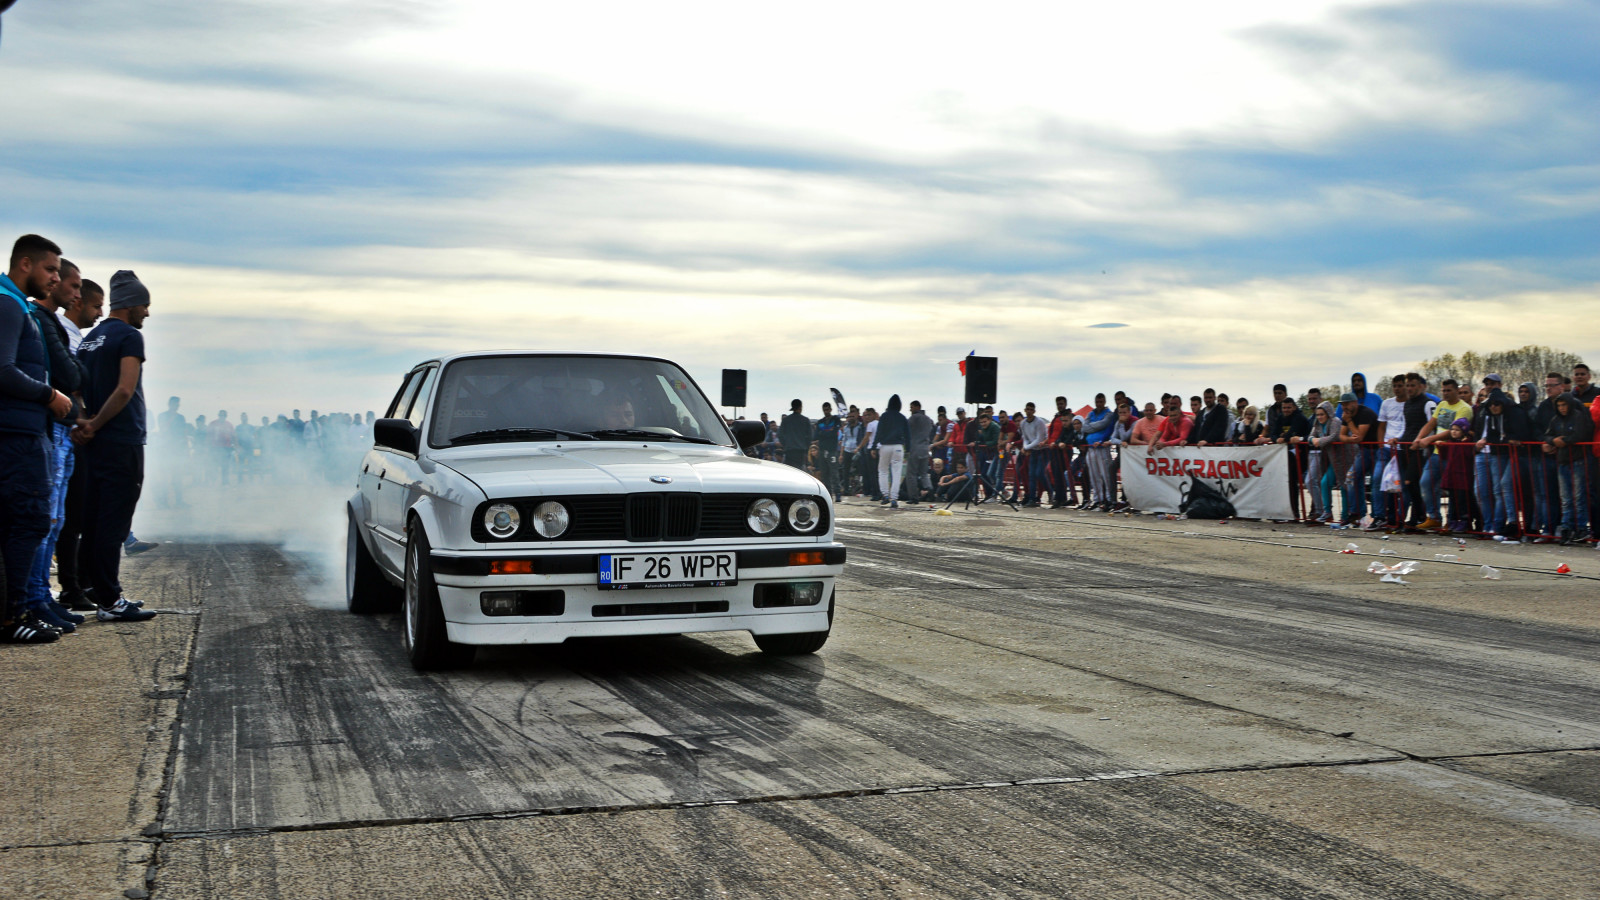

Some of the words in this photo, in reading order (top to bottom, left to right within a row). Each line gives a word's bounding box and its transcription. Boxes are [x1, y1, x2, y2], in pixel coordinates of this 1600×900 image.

[600, 571, 611, 581] RO
[613, 557, 635, 581] IF
[644, 556, 671, 580] 26
[681, 554, 732, 578] WPR
